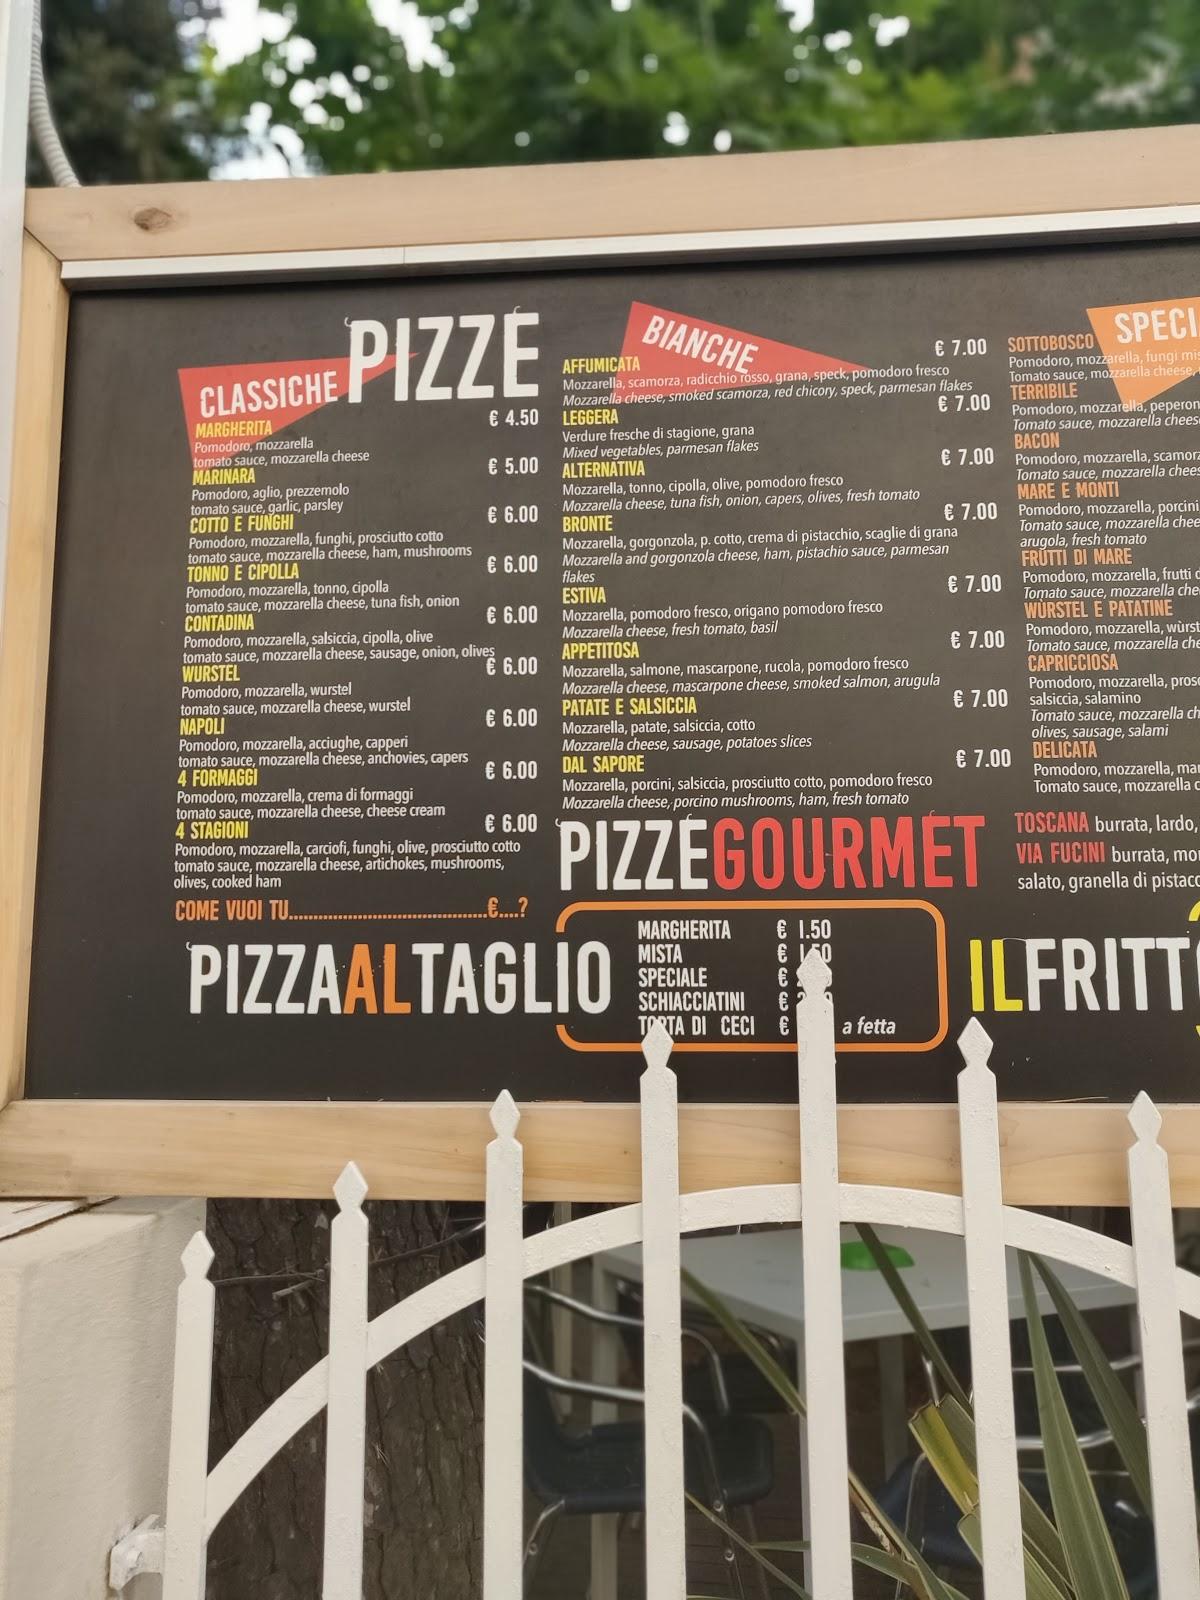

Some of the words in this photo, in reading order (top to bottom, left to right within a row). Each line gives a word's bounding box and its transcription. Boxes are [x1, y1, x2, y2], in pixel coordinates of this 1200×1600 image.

[1114, 307, 1198, 344] SPECI
[642, 314, 759, 376] BIANCHE
[935, 340, 944, 356] €
[951, 339, 987, 355] 7.00
[1008, 334, 1093, 352] SOTTOBOSCO
[348, 312, 539, 403] PIZZE
[563, 356, 640, 373] AFFUMICATA
[200, 370, 338, 418] CLASSICHE
[1010, 383, 1078, 400] TERRIBILE
[490, 410, 498, 426] €
[505, 409, 539, 426] 4.50
[563, 410, 619, 425] LEGGERA
[195, 421, 272, 438] MARGHERITA
[563, 428, 606, 442] Verdure
[609, 427, 649, 440] fresche
[652, 426, 663, 439] di
[666, 425, 718, 442] stagione,
[721, 427, 755, 440] grana
[194, 440, 252, 455] Pomodoro,
[255, 437, 314, 450] mozzarella
[563, 445, 597, 458] Mixed
[600, 442, 664, 460] vegetables,
[667, 444, 723, 458] parmesan
[726, 439, 760, 452] flakes
[1015, 433, 1059, 449] BACON
[193, 457, 231, 468] tomato
[234, 457, 267, 468] sauce,
[270, 451, 328, 465] mozzarella
[331, 450, 370, 462] cheese
[489, 458, 497, 474] €
[505, 457, 539, 474] 5.00
[941, 450, 950, 465] €
[958, 448, 995, 465] 7.00
[192, 468, 255, 485] MARINARA
[563, 462, 645, 478] ALTERNATIVA
[192, 487, 250, 502] Pomodoro,
[252, 486, 282, 502] aglio,
[285, 483, 350, 501] prezzemolo
[563, 481, 626, 497] Mozzarella,
[628, 481, 665, 495] tonno,
[668, 478, 708, 495] cipolla,
[712, 476, 742, 492] olive,
[745, 474, 806, 492] pomodoro
[809, 473, 844, 486] fresco
[1018, 484, 1055, 499] MARE
[1061, 483, 1070, 498] E
[1076, 482, 1120, 498] MONTI
[191, 504, 229, 515] tomato
[231, 505, 265, 516] sauce,
[267, 500, 300, 516] garlic,
[303, 499, 344, 515] parsley
[190, 517, 228, 533] COTTO
[234, 516, 242, 532] E
[247, 515, 294, 531] FUNGHI
[563, 516, 612, 532] BRONTE
[1020, 533, 1068, 550] arugola,
[1071, 532, 1100, 545] fresh
[1104, 533, 1148, 544] tomato
[487, 557, 496, 573] €
[504, 556, 538, 573] 6.00
[1022, 550, 1066, 566] FRUTTI
[1073, 549, 1087, 565] DI
[1093, 548, 1133, 565] MARE
[187, 566, 228, 582] TONNO
[234, 565, 242, 581] E
[248, 563, 300, 580] CIPOLLA
[562, 571, 595, 583] flakes
[948, 576, 957, 593] €
[965, 575, 1002, 592] 7.00
[563, 588, 606, 604] ESTIVA
[1093, 601, 1102, 617] E
[1108, 600, 1174, 617] PATATINE
[185, 614, 254, 632] CONTADINA
[562, 624, 622, 638] Mozzarella
[626, 623, 668, 639] cheese,
[671, 622, 699, 635] fresh
[703, 623, 747, 637] tomato,
[750, 620, 778, 633] basil
[563, 642, 639, 659] APPETITOSA
[486, 659, 495, 675] €
[503, 658, 538, 675] 6.00
[1028, 654, 1119, 671] CAPRICCIOSA
[182, 665, 240, 682] WURSTEL
[563, 700, 609, 716] PATATE
[615, 700, 623, 715] E
[629, 698, 697, 714] SALSICCIA
[1030, 692, 1082, 708] salsiccia,
[1084, 691, 1142, 704] salamino
[180, 718, 224, 735] NAPOLI
[562, 720, 627, 736] Mozzarella,
[630, 721, 670, 736] patate,
[673, 718, 723, 734] salsiccia,
[726, 720, 756, 731] cotto
[1032, 725, 1069, 740] olives,
[1072, 728, 1125, 741] sausage,
[1128, 723, 1169, 736] salami
[956, 750, 966, 768] €
[974, 749, 1011, 767] 7.00
[1033, 741, 1097, 758] DELICATA
[178, 756, 218, 766] tomato
[220, 757, 255, 768] sauce,
[258, 753, 319, 765] mozzarella
[322, 752, 364, 766] cheese,
[367, 751, 428, 766] anchovies,
[430, 754, 469, 766] capers
[563, 757, 587, 774] DAL
[592, 756, 645, 773] SAPORE
[178, 771, 186, 787] 4
[192, 769, 258, 786] FORMAGGI
[177, 790, 237, 806] Pomodoro,
[240, 789, 304, 805] mozzarella,
[307, 793, 342, 802] crema
[345, 788, 357, 801] di
[360, 788, 414, 805] formaggi
[176, 823, 184, 839] 4
[190, 822, 249, 839] STAGIONI
[485, 816, 494, 832] €
[502, 815, 538, 832] 6.00
[1015, 812, 1089, 833] TOSCANA
[1096, 815, 1152, 835] burrata,
[1156, 814, 1199, 834] lardo,
[1016, 843, 1042, 864] VIA
[1050, 842, 1105, 863] FUCINI
[1112, 845, 1169, 866] burrata,
[174, 875, 209, 890] olives,
[211, 875, 252, 888] cooked
[255, 874, 282, 887] ham
[1018, 872, 1064, 892] salato,
[1068, 871, 1128, 893] granella
[1133, 871, 1147, 887] di
[176, 901, 218, 920] COME
[226, 901, 262, 919] VUOI
[638, 920, 731, 939] MARGHERITA
[777, 920, 786, 938] €
[799, 920, 832, 938] 1.50
[638, 944, 682, 963] MISTA
[778, 944, 787, 964] €
[800, 943, 832, 963] 10
[639, 968, 707, 987] SPECIALE
[639, 992, 745, 1011] SCHIACCIATINI
[692, 1016, 706, 1035] DI
[721, 1016, 754, 1035] CECI
[842, 1022, 852, 1034] a
[856, 1016, 896, 1034] fetta
